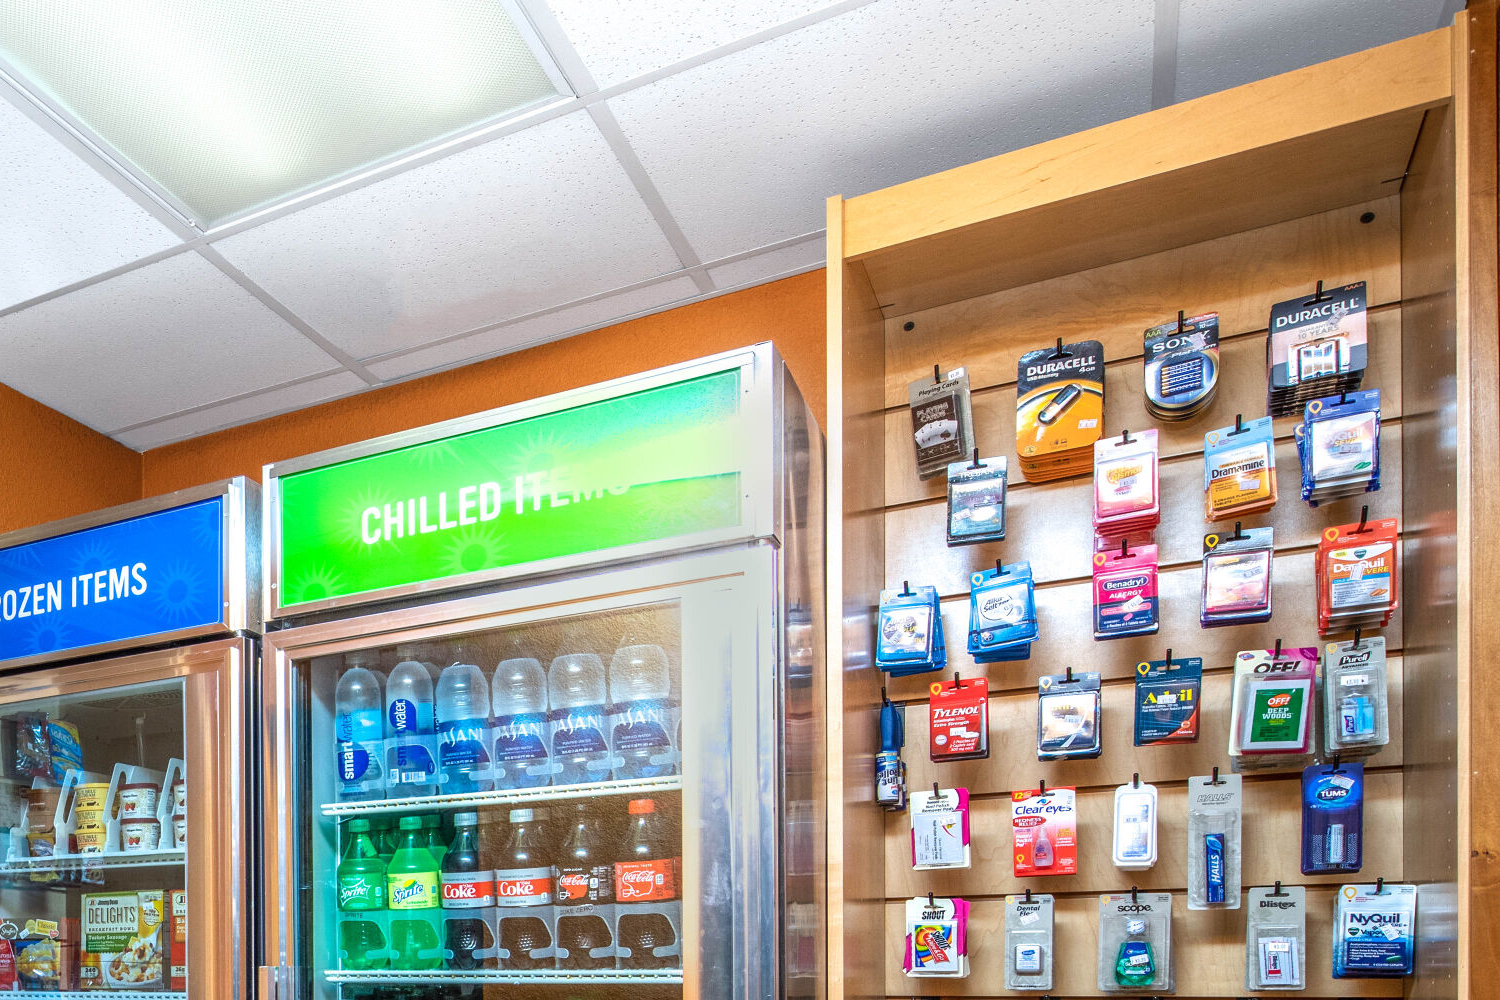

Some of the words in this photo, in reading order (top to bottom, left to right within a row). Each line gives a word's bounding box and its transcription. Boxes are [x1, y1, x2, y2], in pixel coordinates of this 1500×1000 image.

[1275, 298, 1360, 329] DURACELL
[1146, 328, 1162, 338] AAA
[1027, 356, 1096, 377] DURACELL
[918, 385, 941, 397] Playing
[942, 380, 959, 390] Cards
[1211, 459, 1265, 479] Dramamine
[360, 480, 502, 545] CHILLED
[71, 562, 148, 608] ITEMS
[1105, 578, 1146, 589] Benadryl
[1108, 589, 1143, 599] ALLERGY
[1253, 661, 1301, 673] OFF!
[1267, 696, 1290, 707] OFF!
[933, 706, 979, 718] TYLENOL
[1267, 707, 1289, 715] DEEP
[344, 741, 355, 780] smart
[1321, 789, 1347, 798] TUMS
[1015, 805, 1045, 815] Clear
[1046, 804, 1072, 814] eyes
[1212, 853, 1222, 883] HALLS
[622, 870, 654, 885] Coca-Cola
[340, 885, 368, 902] Sprite
[393, 883, 423, 903] Sprite
[444, 885, 476, 899] Coke
[500, 882, 534, 897] Coke
[1117, 905, 1151, 913] scope
[1259, 900, 1296, 909] Blistex
[88, 907, 135, 924] DELIGHTS
[922, 910, 945, 920] SHOUT
[1349, 912, 1401, 925] NyQuil
